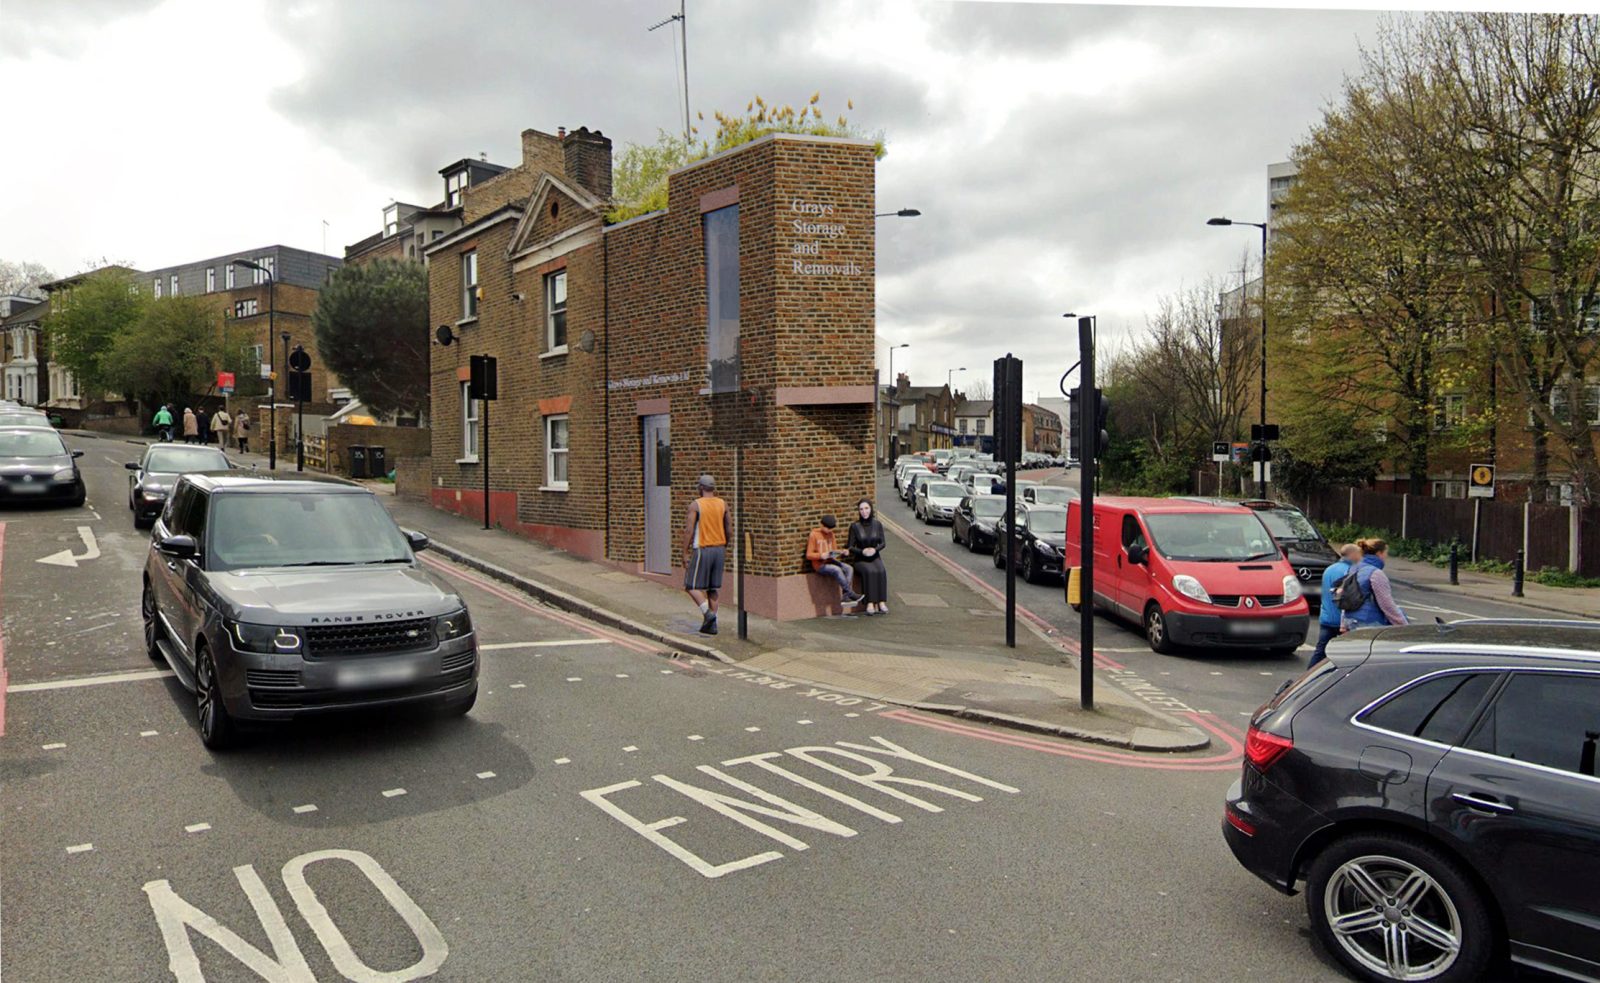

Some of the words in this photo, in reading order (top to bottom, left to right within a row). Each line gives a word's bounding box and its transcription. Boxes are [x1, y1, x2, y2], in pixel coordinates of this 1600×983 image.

[792, 199, 834, 217] Grays
[792, 219, 846, 238] Storage
[793, 241, 819, 255] and
[792, 261, 862, 275] Removals
[375, 610, 425, 620] ROVER
[796, 688, 887, 711] LOOK
[141, 849, 449, 983] NO
[579, 736, 1021, 878] ENTRY
